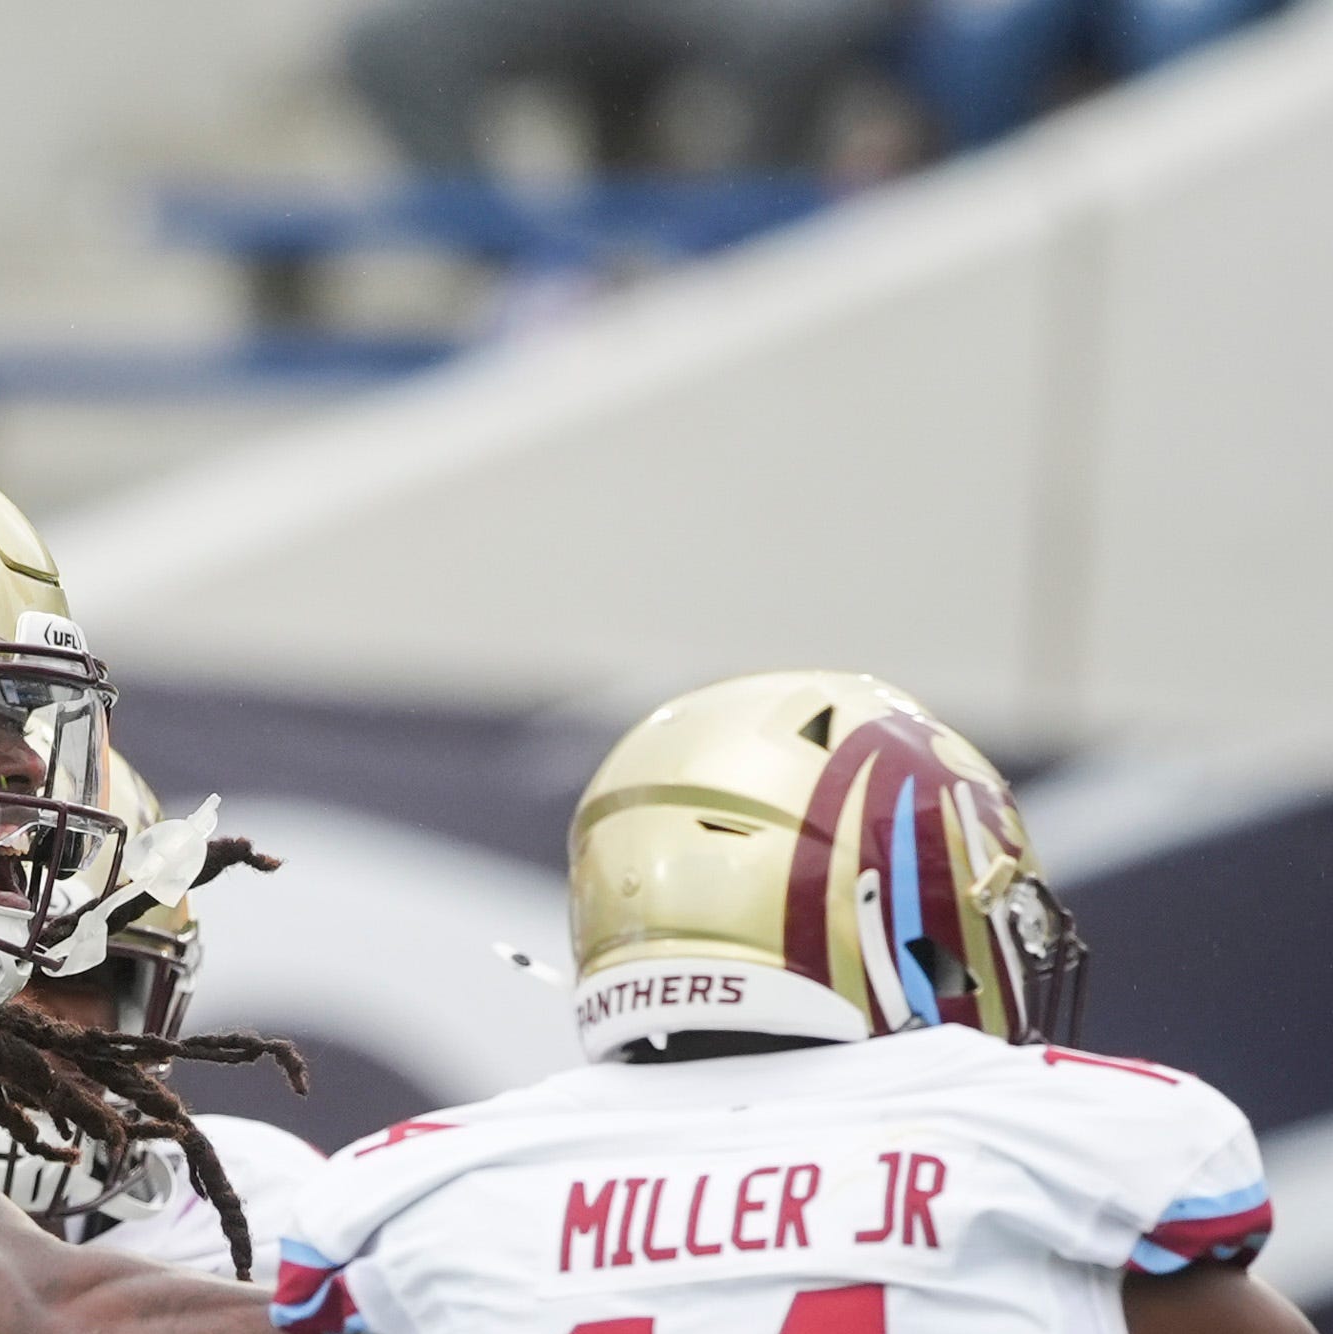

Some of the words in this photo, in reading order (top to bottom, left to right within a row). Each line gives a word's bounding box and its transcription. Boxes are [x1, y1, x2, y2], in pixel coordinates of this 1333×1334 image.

[53, 630, 78, 650] UFL
[577, 975, 746, 1028] PANTHERS
[558, 1162, 820, 1274] MILLER
[854, 1150, 948, 1250] JR
